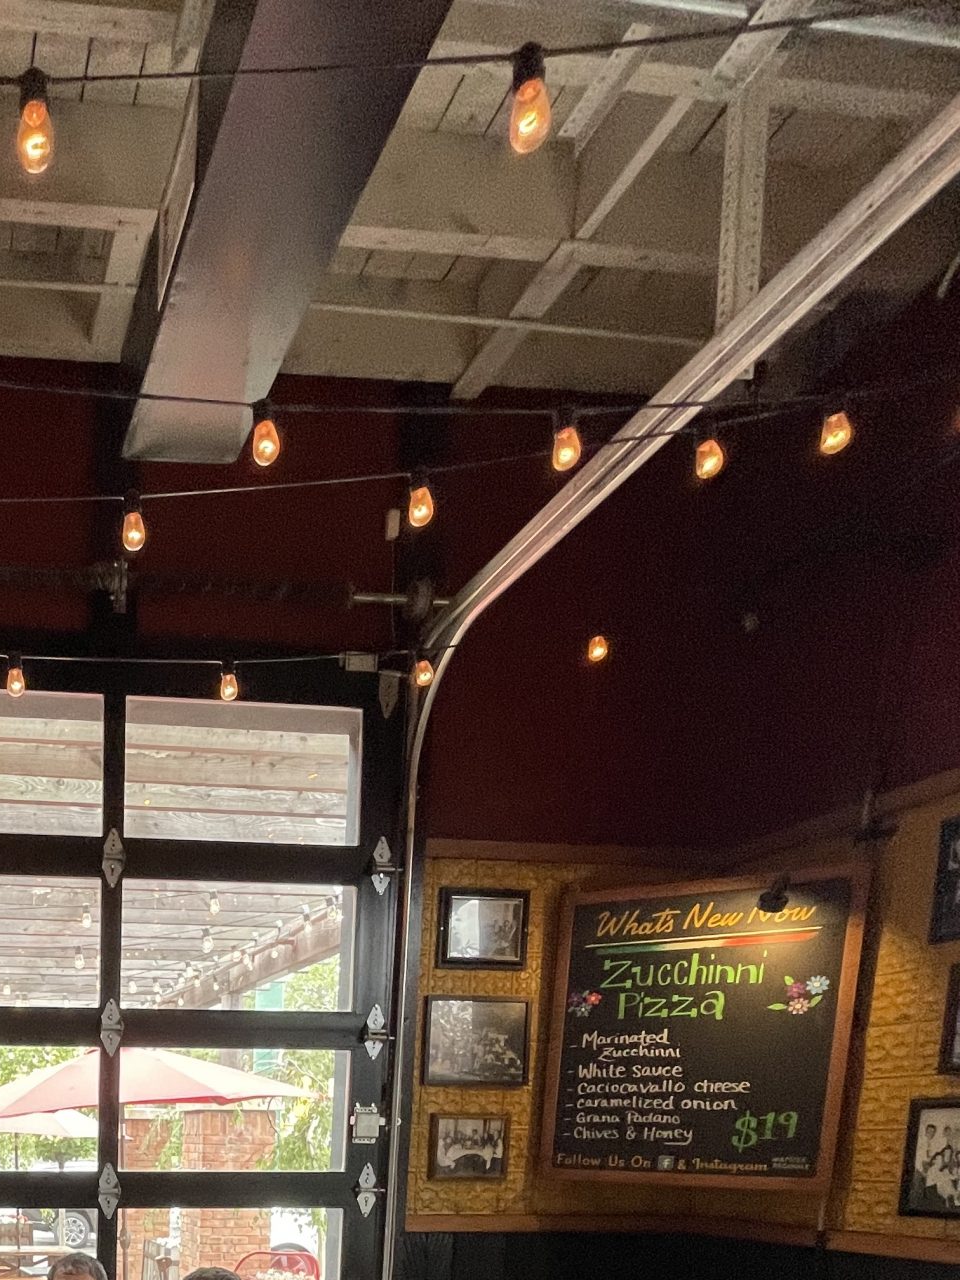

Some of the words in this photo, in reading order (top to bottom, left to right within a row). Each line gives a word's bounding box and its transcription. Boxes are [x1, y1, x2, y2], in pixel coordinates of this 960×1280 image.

[597, 907, 681, 937] What's
[682, 902, 744, 929] New
[600, 950, 768, 989] Zucchinni
[617, 990, 725, 1020] Pizza
[582, 1028, 671, 1050] Marinated
[598, 1044, 681, 1061] Zucchinni
[578, 1063, 626, 1078] White
[694, 1079, 751, 1094] cheese
[681, 1099, 738, 1111] onion
[575, 1112, 620, 1124] Grana
[625, 1110, 681, 1124] Padano
[573, 1126, 620, 1140] Chives
[625, 1127, 636, 1140] &
[643, 1127, 693, 1145] Honey
[731, 1109, 798, 1153] $19
[556, 1153, 601, 1168] Follow
[608, 1155, 626, 1168] Us
[631, 1155, 651, 1168] On
[692, 1158, 768, 1174] Instagram
